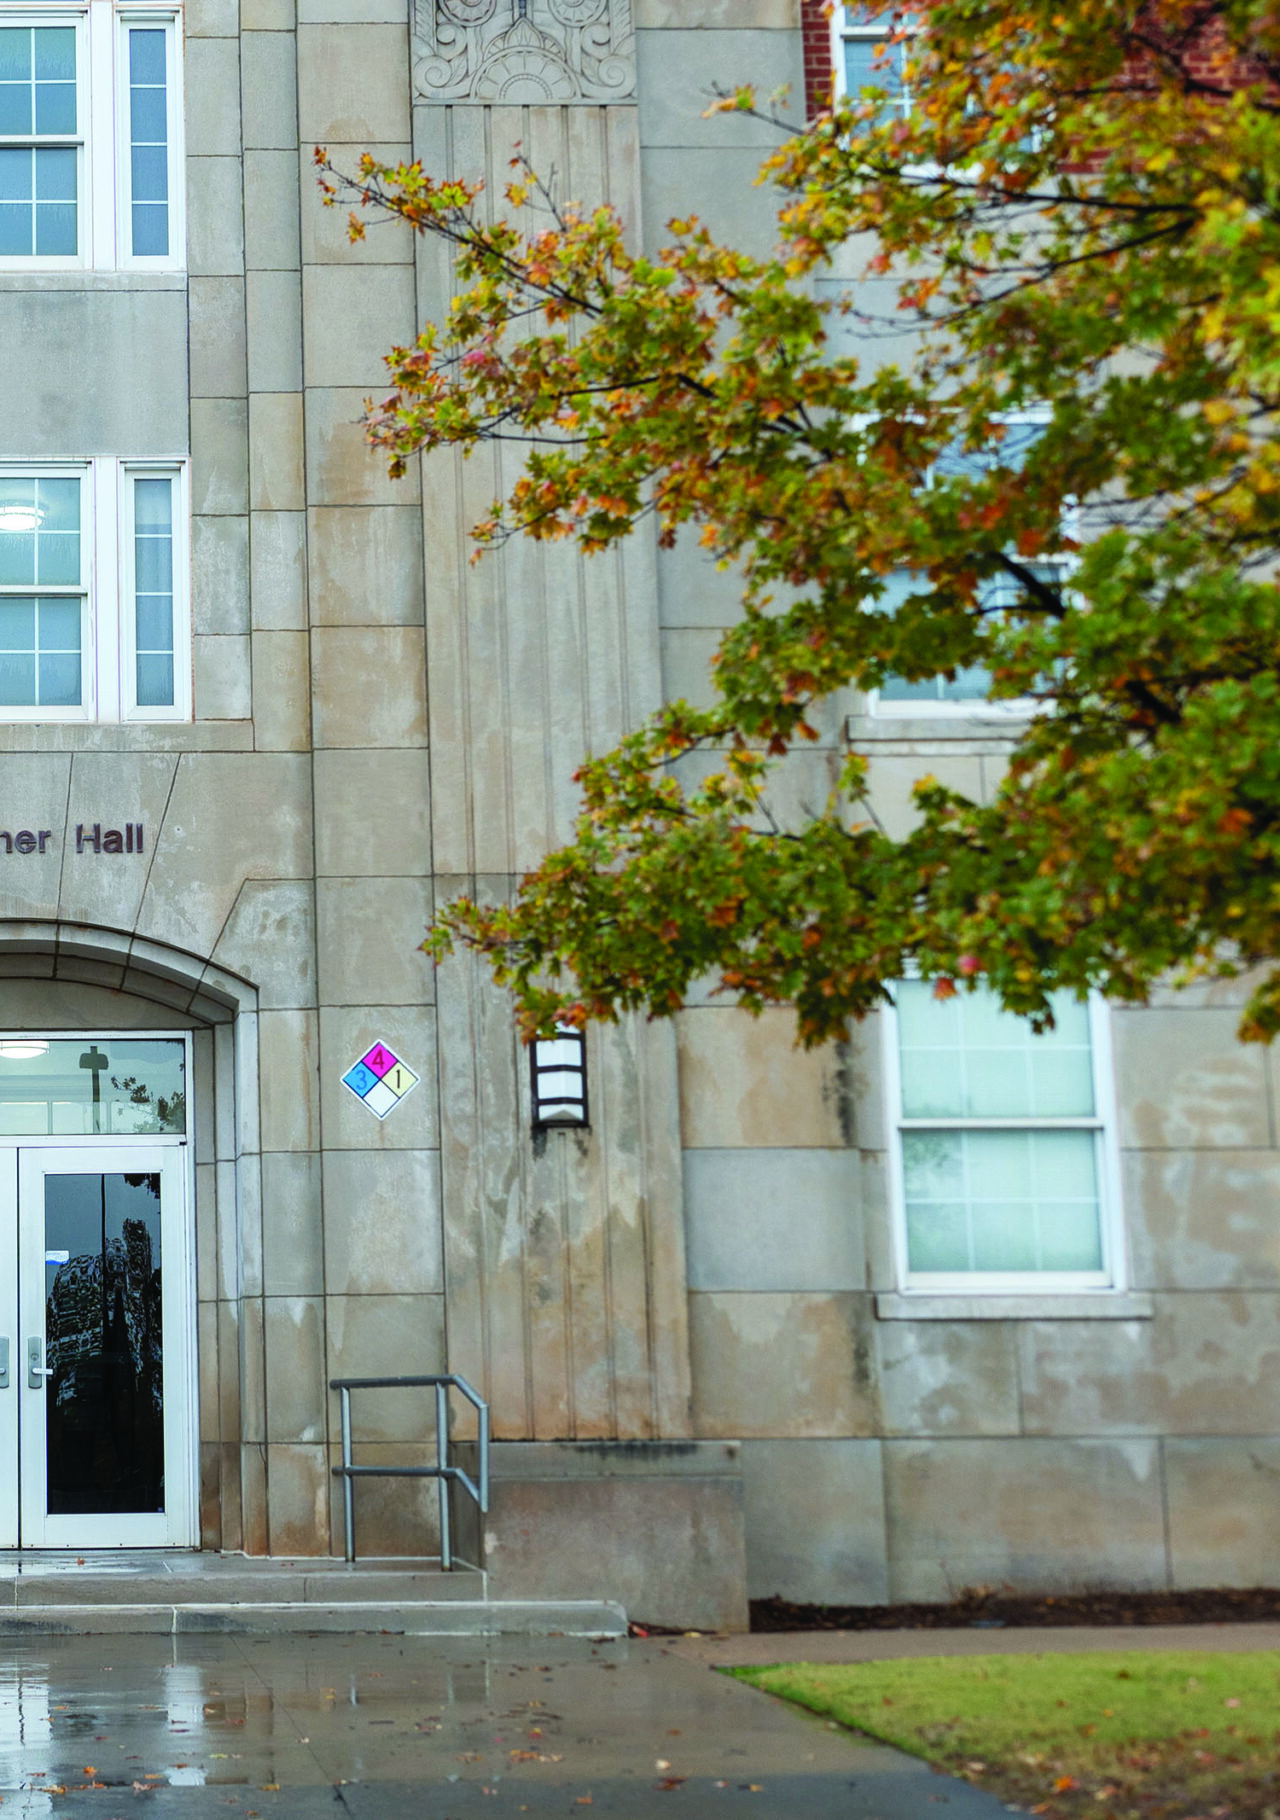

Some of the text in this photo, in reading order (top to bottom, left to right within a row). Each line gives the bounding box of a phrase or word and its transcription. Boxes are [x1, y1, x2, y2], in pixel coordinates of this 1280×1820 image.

[75, 823, 144, 855] Hall
[371, 1049, 385, 1069] 4
[355, 1069, 368, 1090] 3
